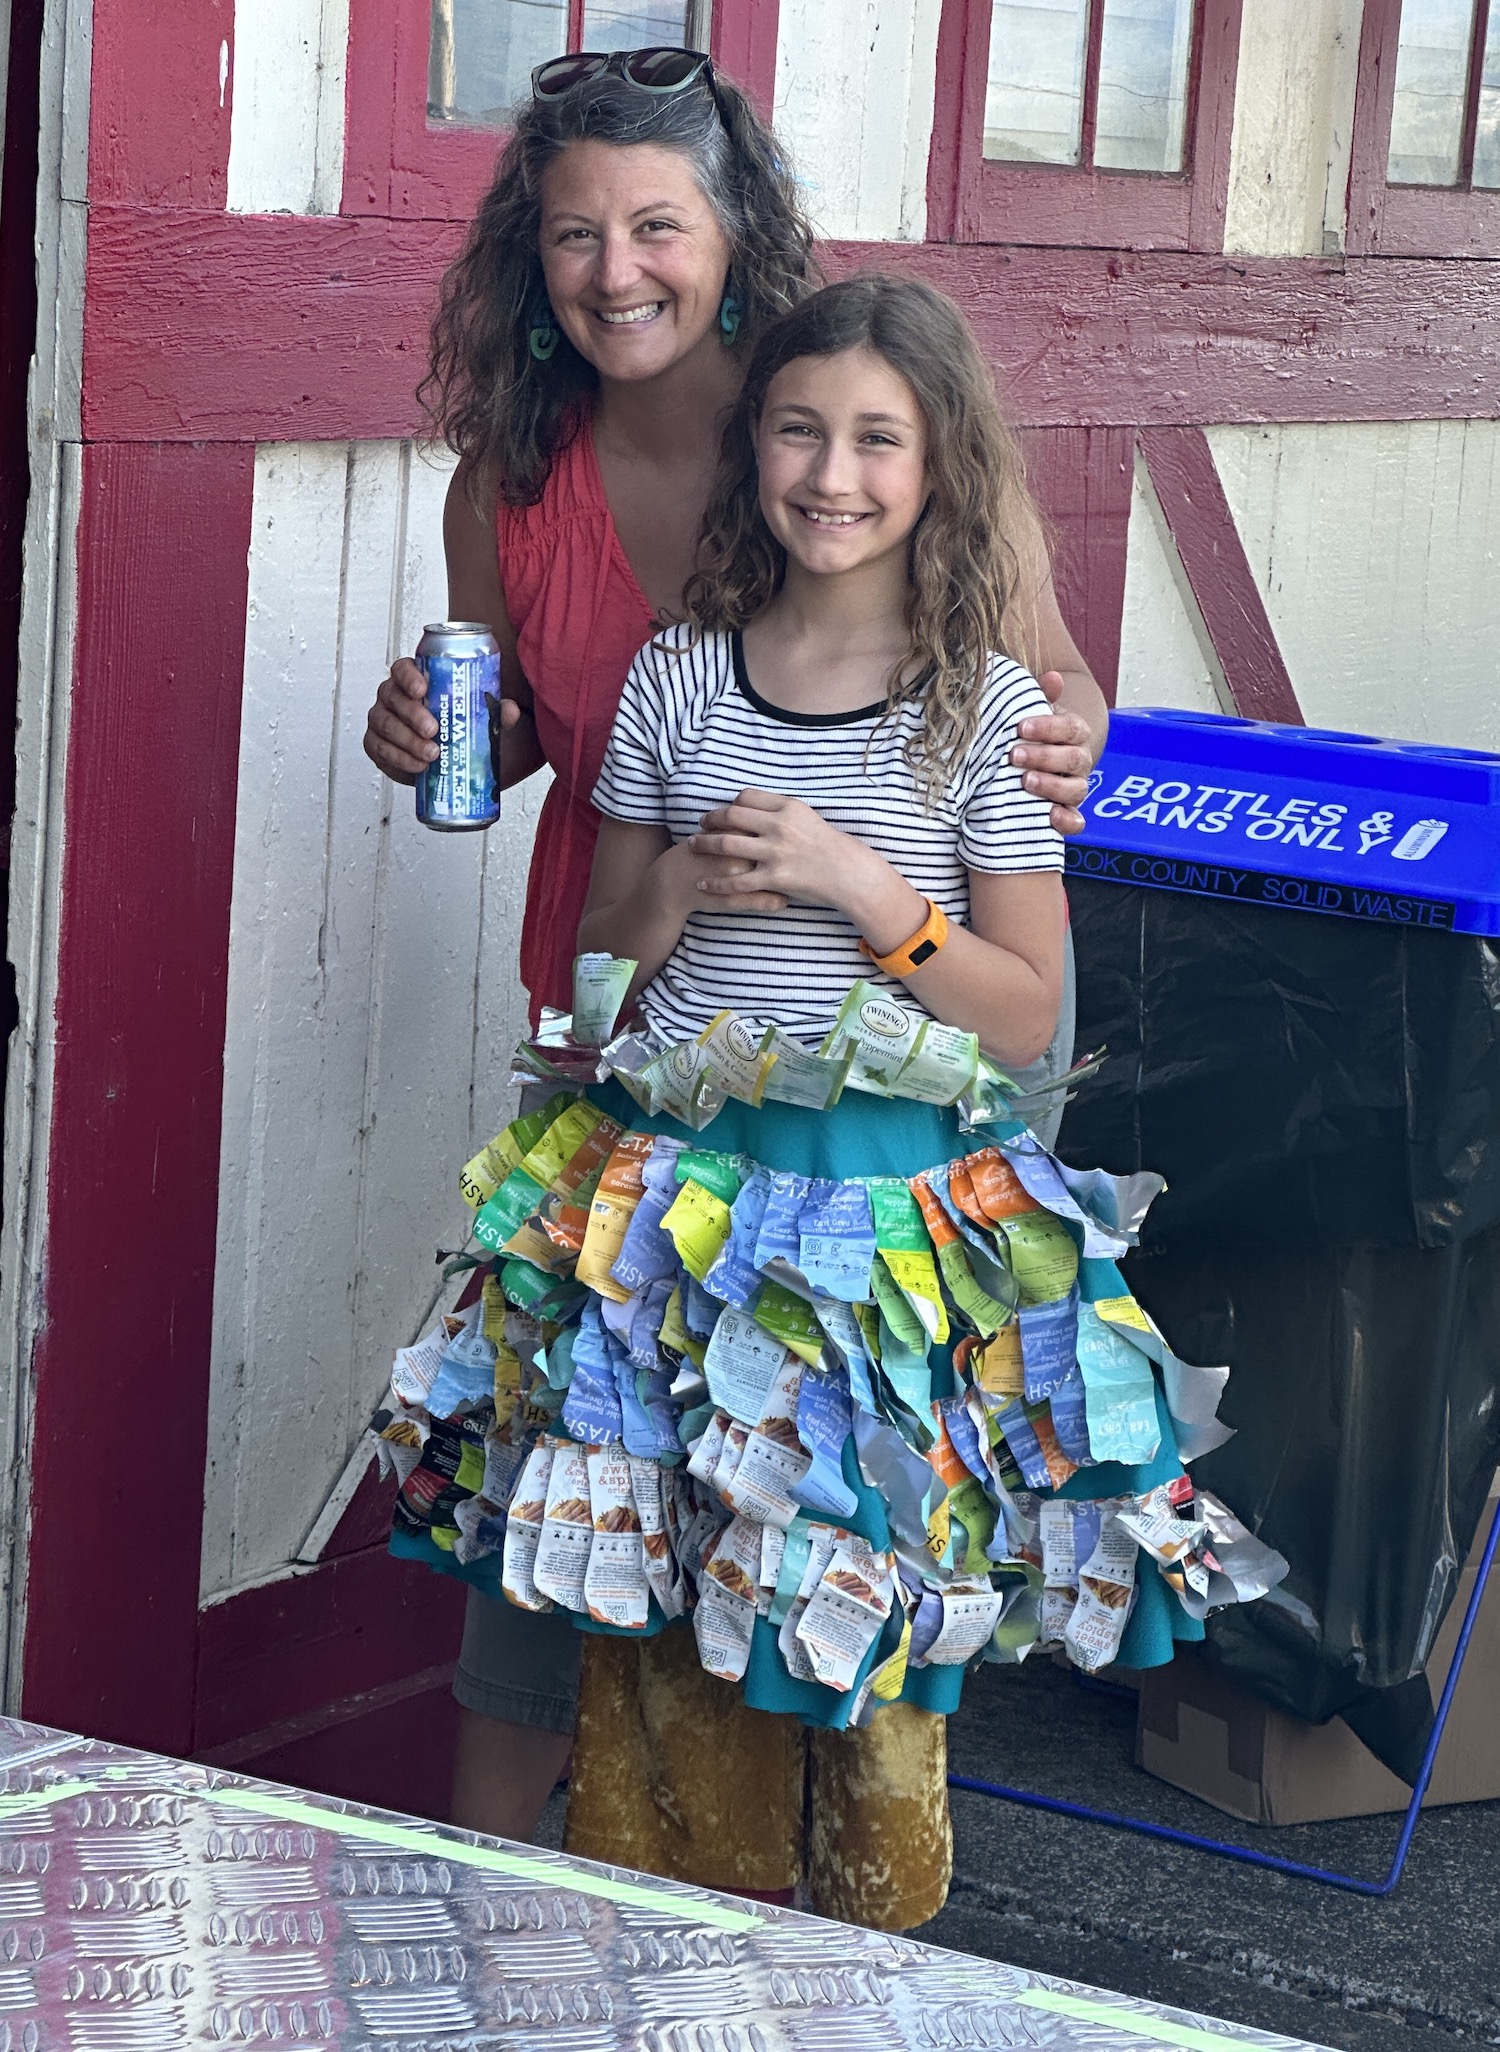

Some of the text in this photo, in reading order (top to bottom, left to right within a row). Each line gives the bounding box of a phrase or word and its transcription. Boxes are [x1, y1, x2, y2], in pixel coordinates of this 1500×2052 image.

[452, 662, 466, 743] WEEK
[440, 694, 449, 776] FORT GEORGE
[452, 748, 459, 761] OF
[452, 768, 466, 815] PET
[1113, 775, 1394, 835] BOTTLES &
[1093, 799, 1393, 855] CANS ONLY
[1130, 858, 1248, 893] COUNTY
[1262, 877, 1342, 909] SOLID
[1352, 891, 1449, 928] WASTE
[854, 1025, 896, 1049] HERBAL TEA
[865, 1005, 907, 1030] TWININGS
[706, 1037, 725, 1064] Lemon
[730, 1065, 755, 1088] Ginger
[859, 1037, 904, 1063] Peppermint
[1074, 1631, 1111, 1650] sweet
